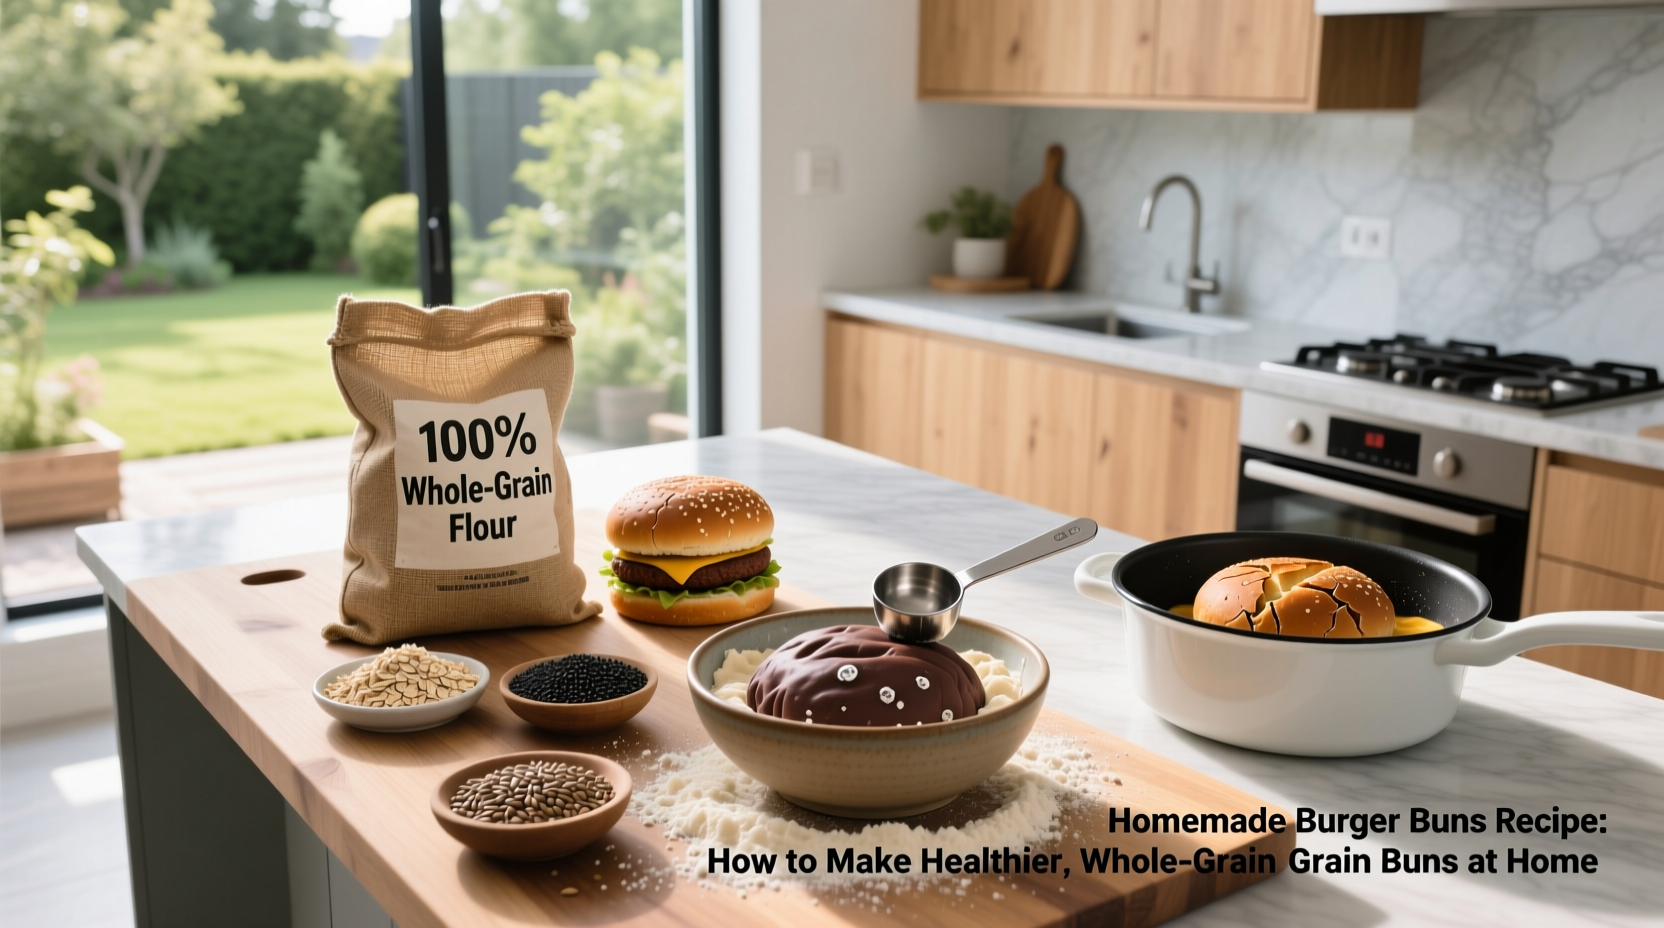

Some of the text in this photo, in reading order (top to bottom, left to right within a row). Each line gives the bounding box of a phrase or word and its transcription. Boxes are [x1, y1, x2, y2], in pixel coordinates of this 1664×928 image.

[418, 411, 537, 463] 100%
[401, 466, 553, 506] Whole-Grain
[449, 511, 518, 543] Flour
